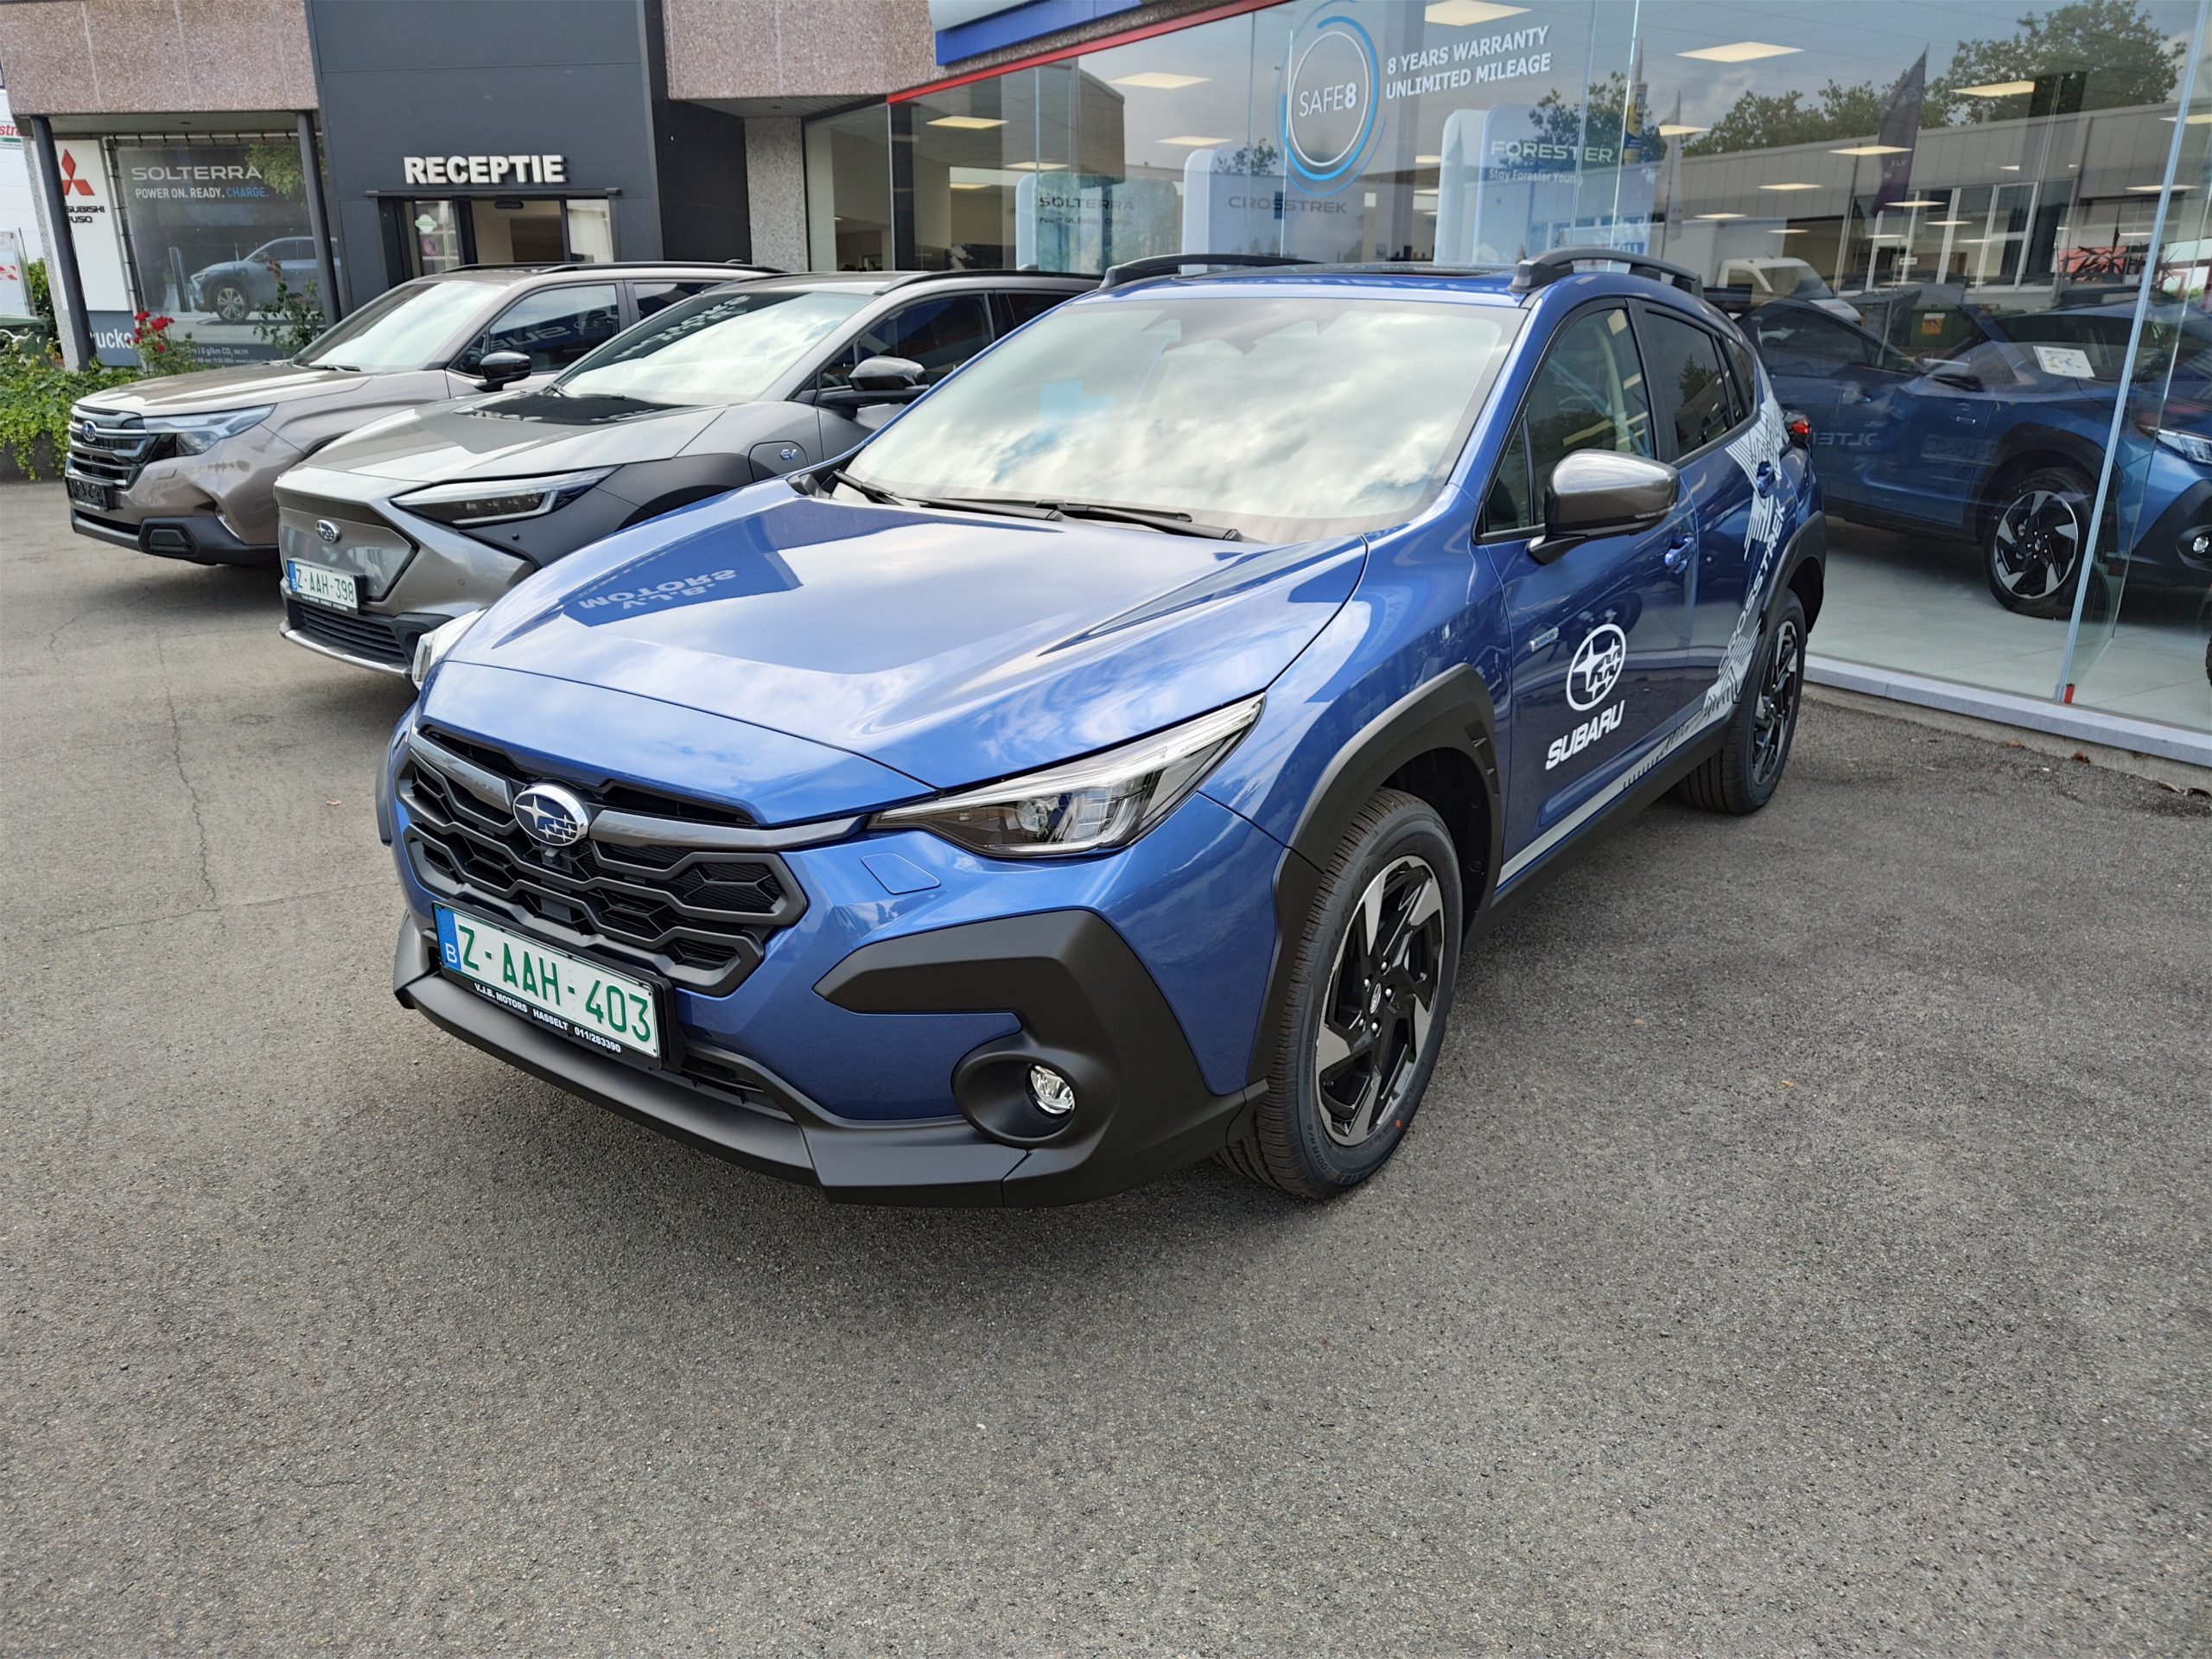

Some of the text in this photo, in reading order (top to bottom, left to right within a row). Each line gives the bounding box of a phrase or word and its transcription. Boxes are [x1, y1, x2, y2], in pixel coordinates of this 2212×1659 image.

[1388, 25, 1549, 74] 8 YEARS WARRANTY
[1386, 53, 1552, 99] UNLIMITED MILEAGE
[1300, 82, 1357, 117] SAFE8
[1491, 140, 1613, 162] FORESTER
[131, 165, 262, 181] SOLTERRA
[404, 155, 566, 184] RECEPTIE
[1489, 168, 1583, 187] Stay Forester Young
[136, 186, 269, 199] POWER ON. READY. CHARGE.
[1039, 197, 1135, 210] SOLTERRA
[1228, 196, 1347, 213] CROSSTREK
[90, 328, 133, 349] ucks
[780, 448, 797, 460] EV
[296, 568, 354, 603] Z-AAH-398
[1718, 497, 1785, 676] CROSSTREK
[1545, 699, 1625, 771] SUBARU
[444, 942, 458, 964] B
[458, 924, 651, 1042] Z-AAH-403
[474, 982, 621, 1053] V.J.B. MOTORS HASSELT 011/283390
